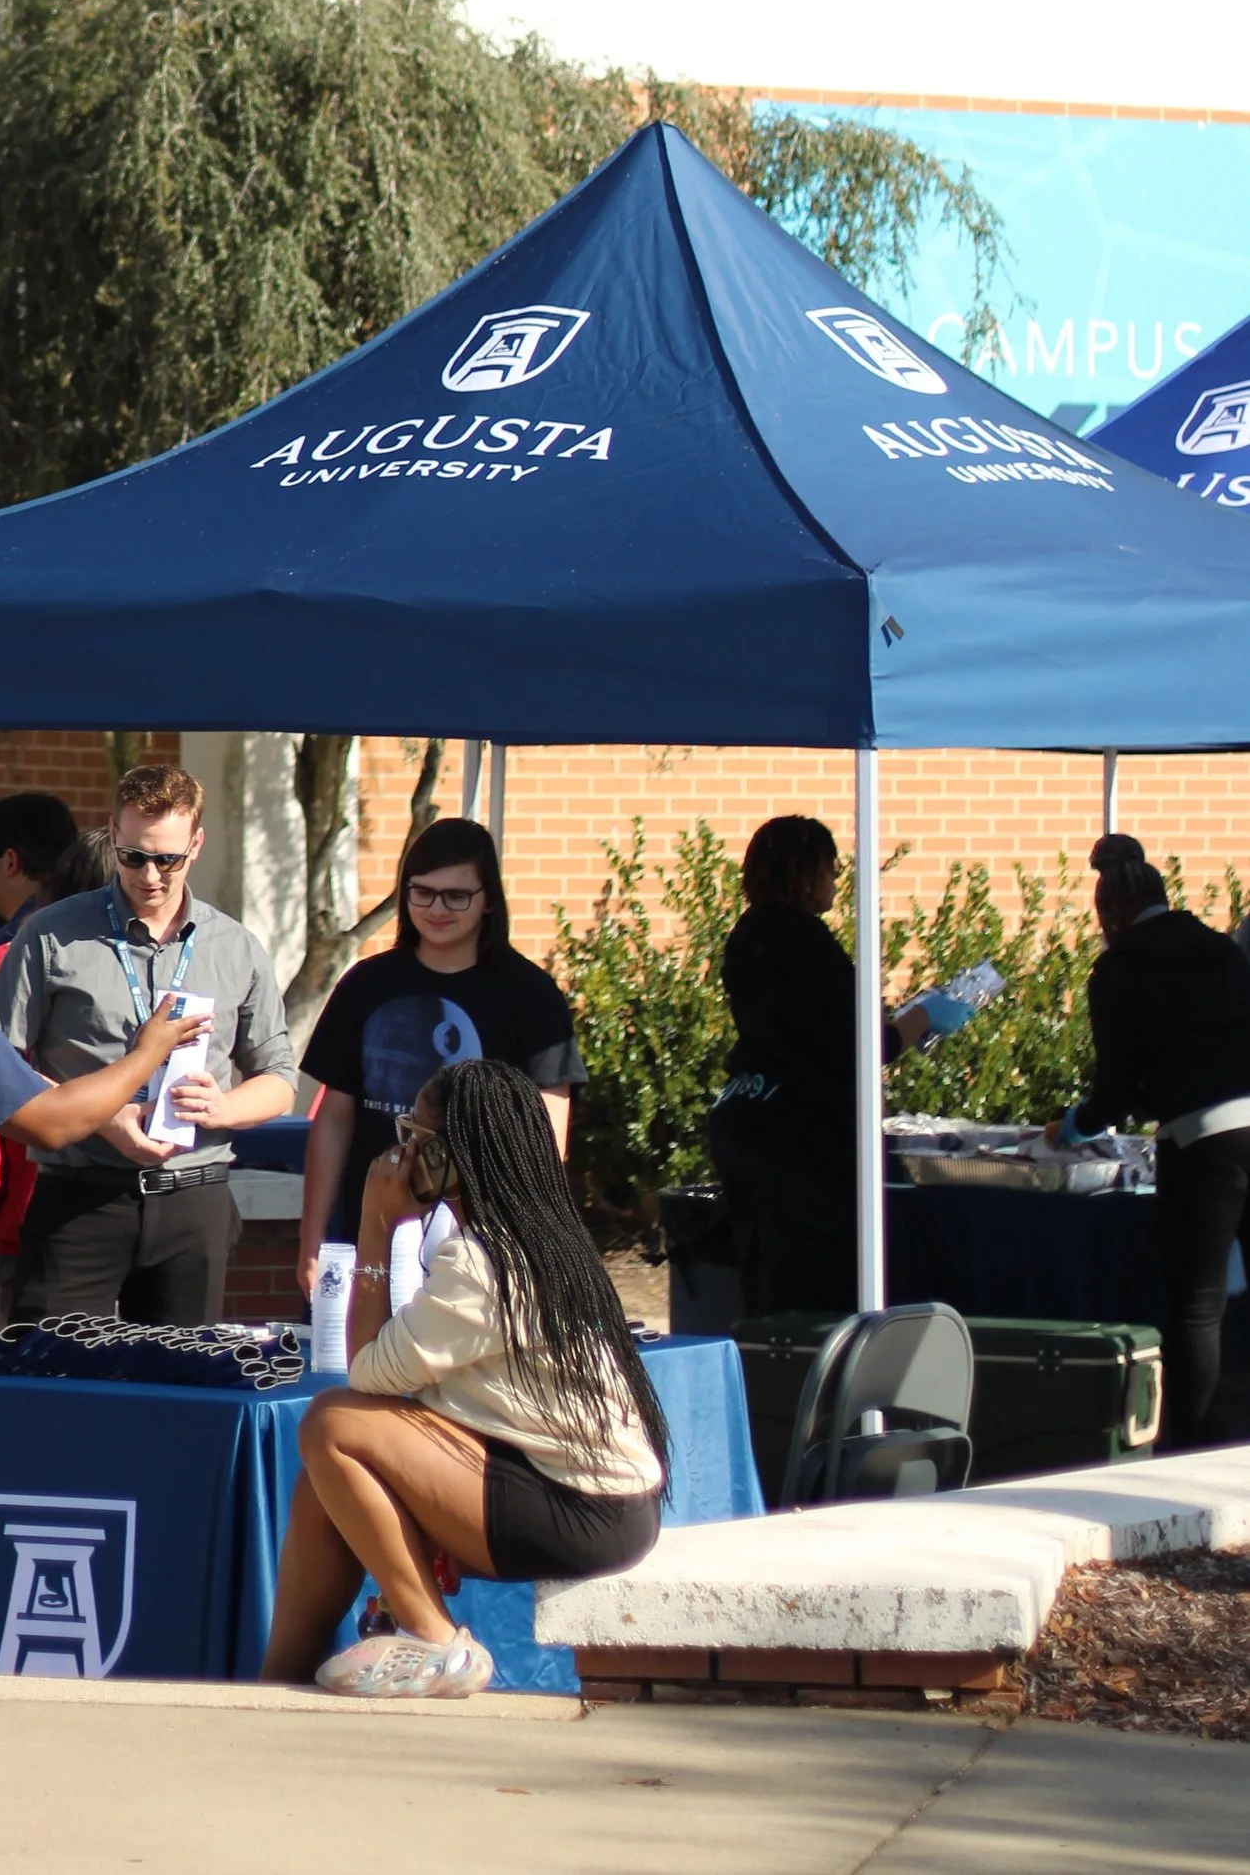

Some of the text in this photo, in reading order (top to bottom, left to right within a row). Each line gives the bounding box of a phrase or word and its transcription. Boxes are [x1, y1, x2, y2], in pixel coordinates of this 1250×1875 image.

[250, 414, 614, 469] AUGUSTA
[862, 416, 1115, 476] AUGUSTA
[279, 459, 540, 488] UNIVERSITY
[945, 461, 1116, 492] UNIVERSITY
